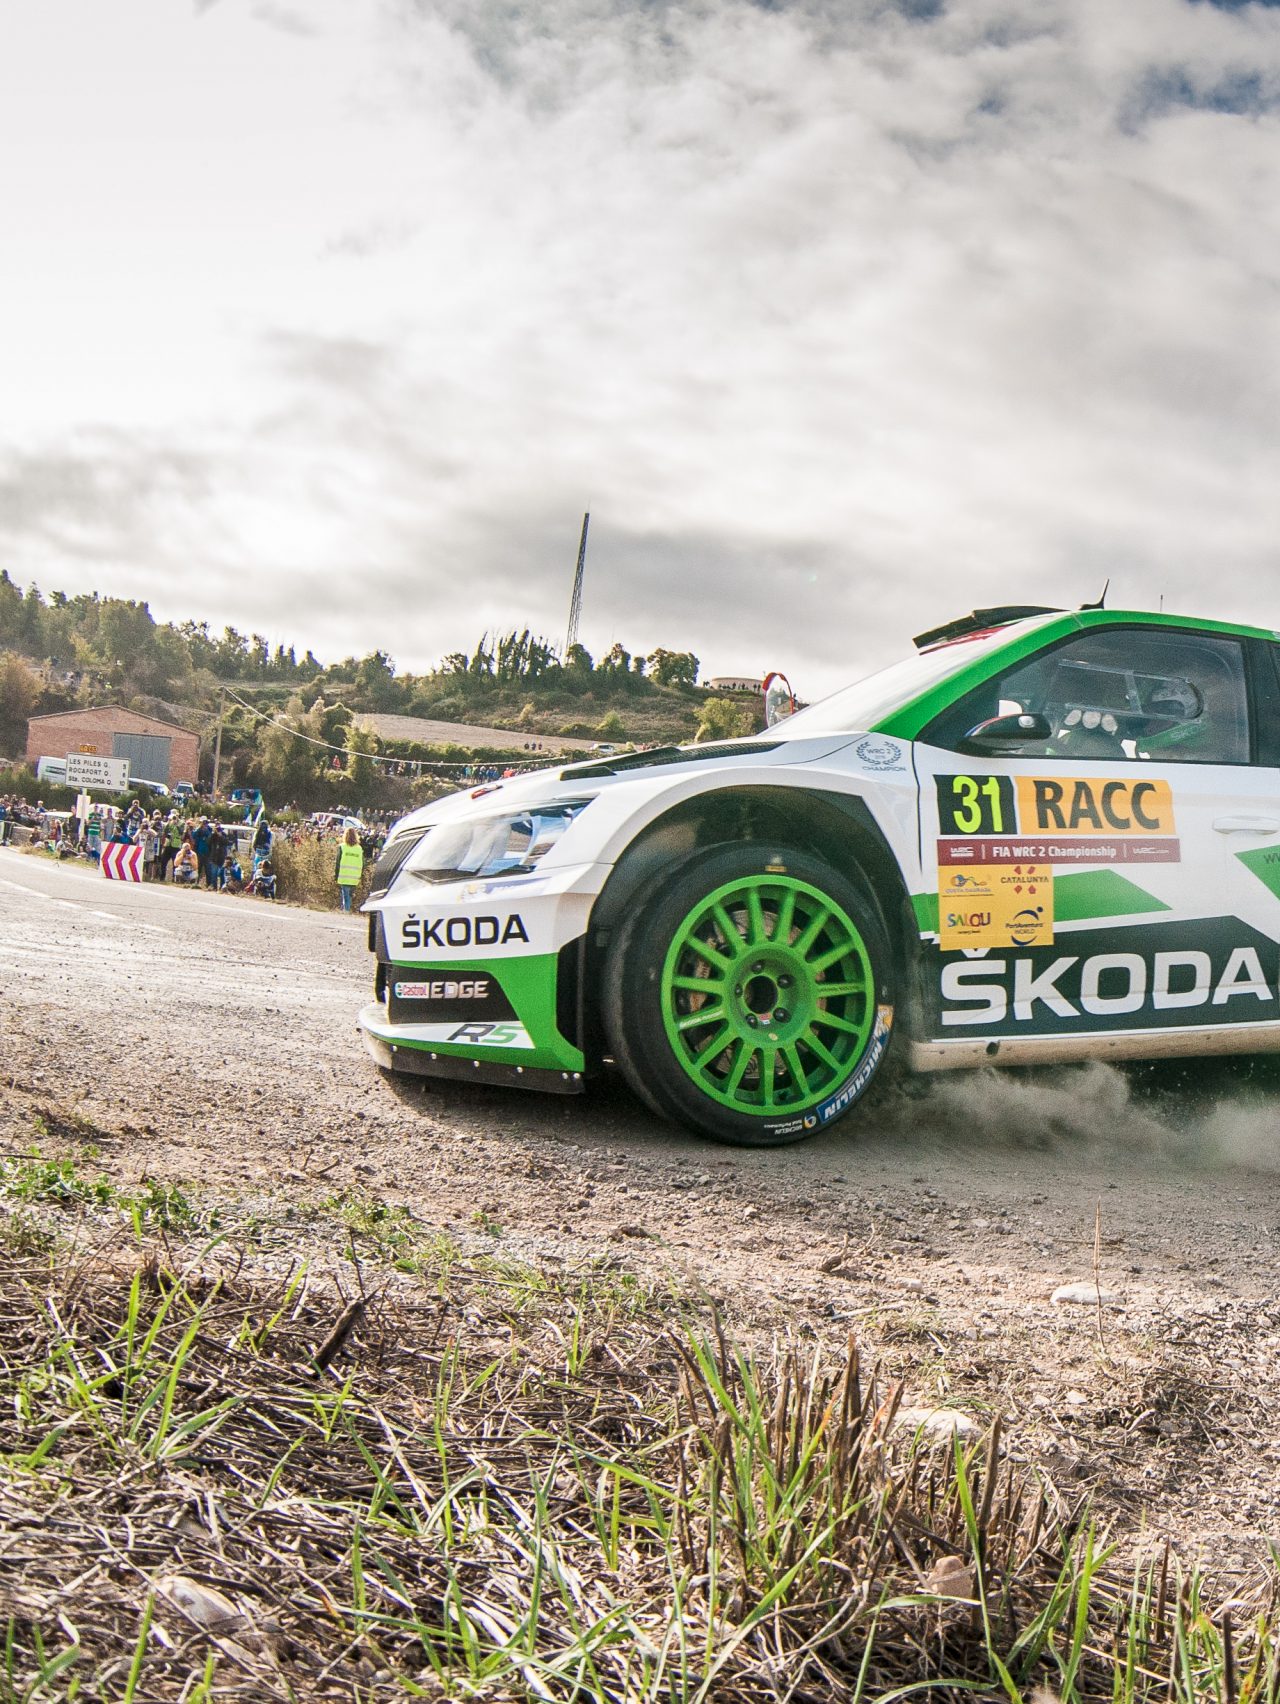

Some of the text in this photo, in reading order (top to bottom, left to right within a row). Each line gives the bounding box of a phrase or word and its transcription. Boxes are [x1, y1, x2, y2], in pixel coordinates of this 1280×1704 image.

[68, 767, 102, 775] ROCAFORT
[952, 775, 1161, 834] 31 RACC
[992, 845, 1117, 859] FIA WRC 2 Championship
[1000, 876, 1050, 884] CATALUNYA
[947, 911, 991, 928] SALOU
[402, 913, 530, 949] ŠKODA
[403, 981, 489, 999] Castrol EDGE
[446, 1023, 524, 1043] R5
[823, 1041, 883, 1120] MICHELIN
